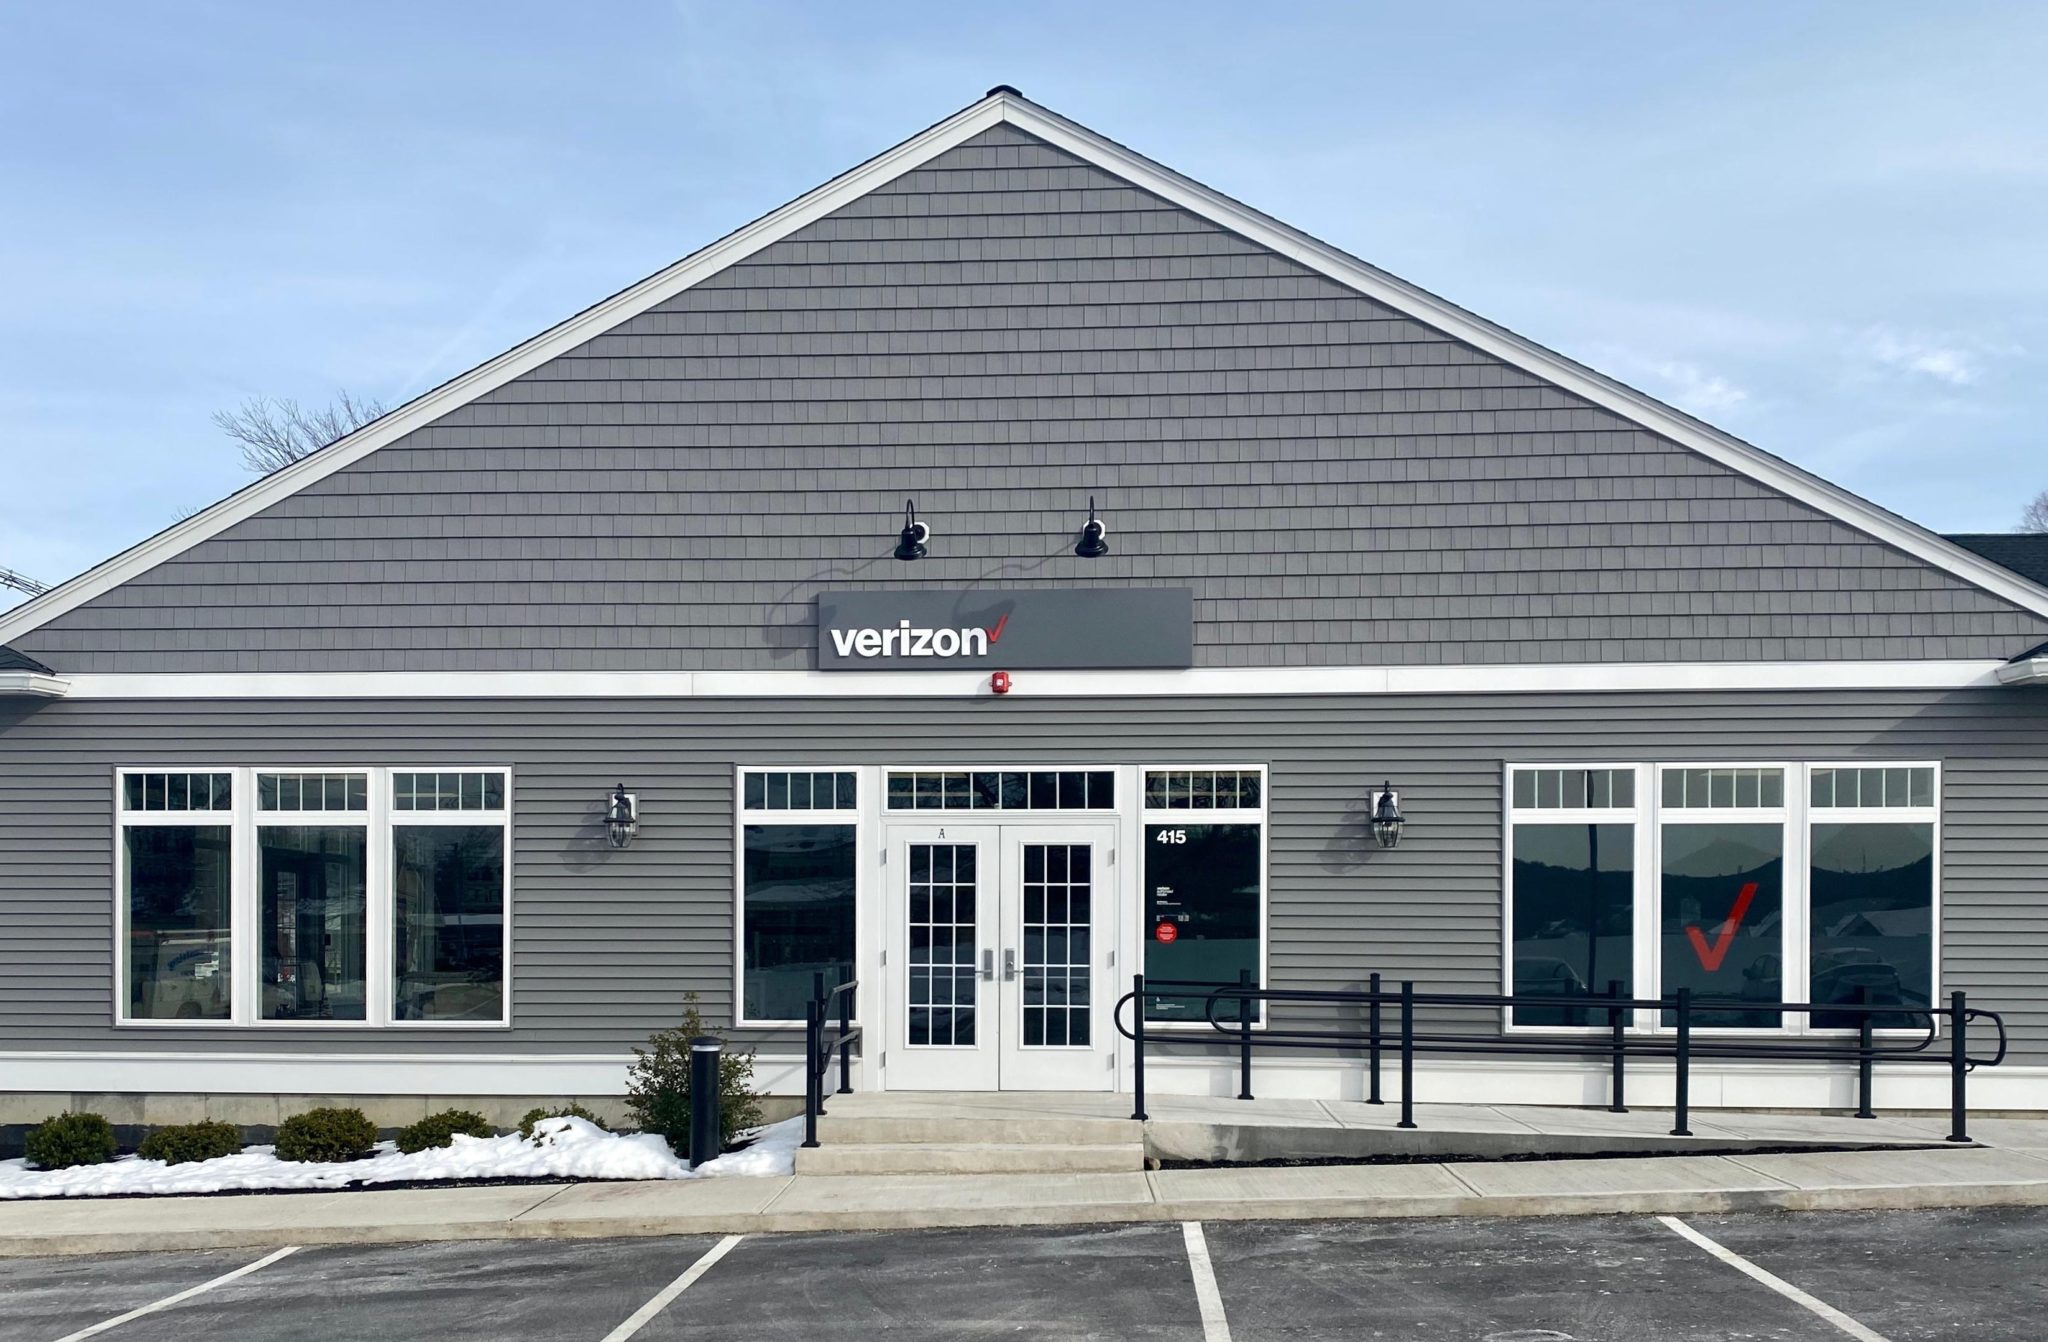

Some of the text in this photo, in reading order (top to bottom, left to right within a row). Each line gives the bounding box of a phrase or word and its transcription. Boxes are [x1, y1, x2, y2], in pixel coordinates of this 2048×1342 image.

[830, 619, 988, 657] verizon
[938, 828, 945, 839] A
[1156, 829, 1187, 844] 415
